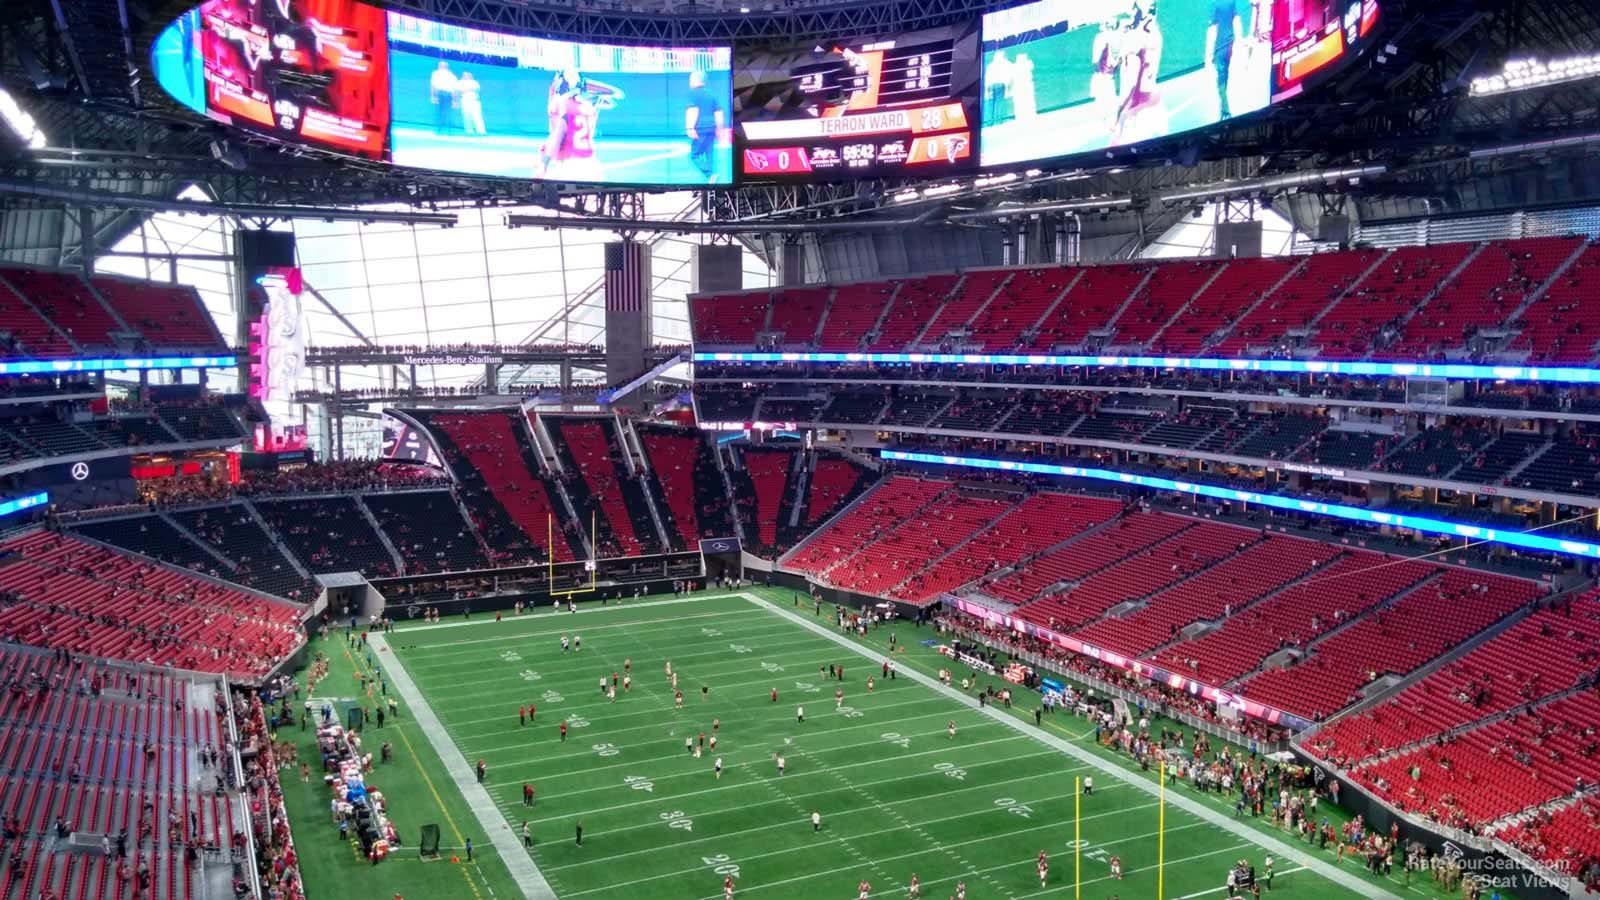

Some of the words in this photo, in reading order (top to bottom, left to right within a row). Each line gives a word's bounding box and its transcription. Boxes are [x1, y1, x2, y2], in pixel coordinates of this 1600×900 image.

[819, 115, 865, 133] TERRON
[868, 112, 904, 129] WARD
[922, 109, 942, 129] 28
[843, 144, 875, 160] 59:42
[926, 141, 938, 158] 0
[777, 151, 789, 169] 0
[404, 355, 467, 364] Mercedes-Benz
[468, 355, 503, 364] Stadium
[624, 776, 654, 790] 40
[660, 811, 693, 829] 30
[702, 854, 740, 875] 20
